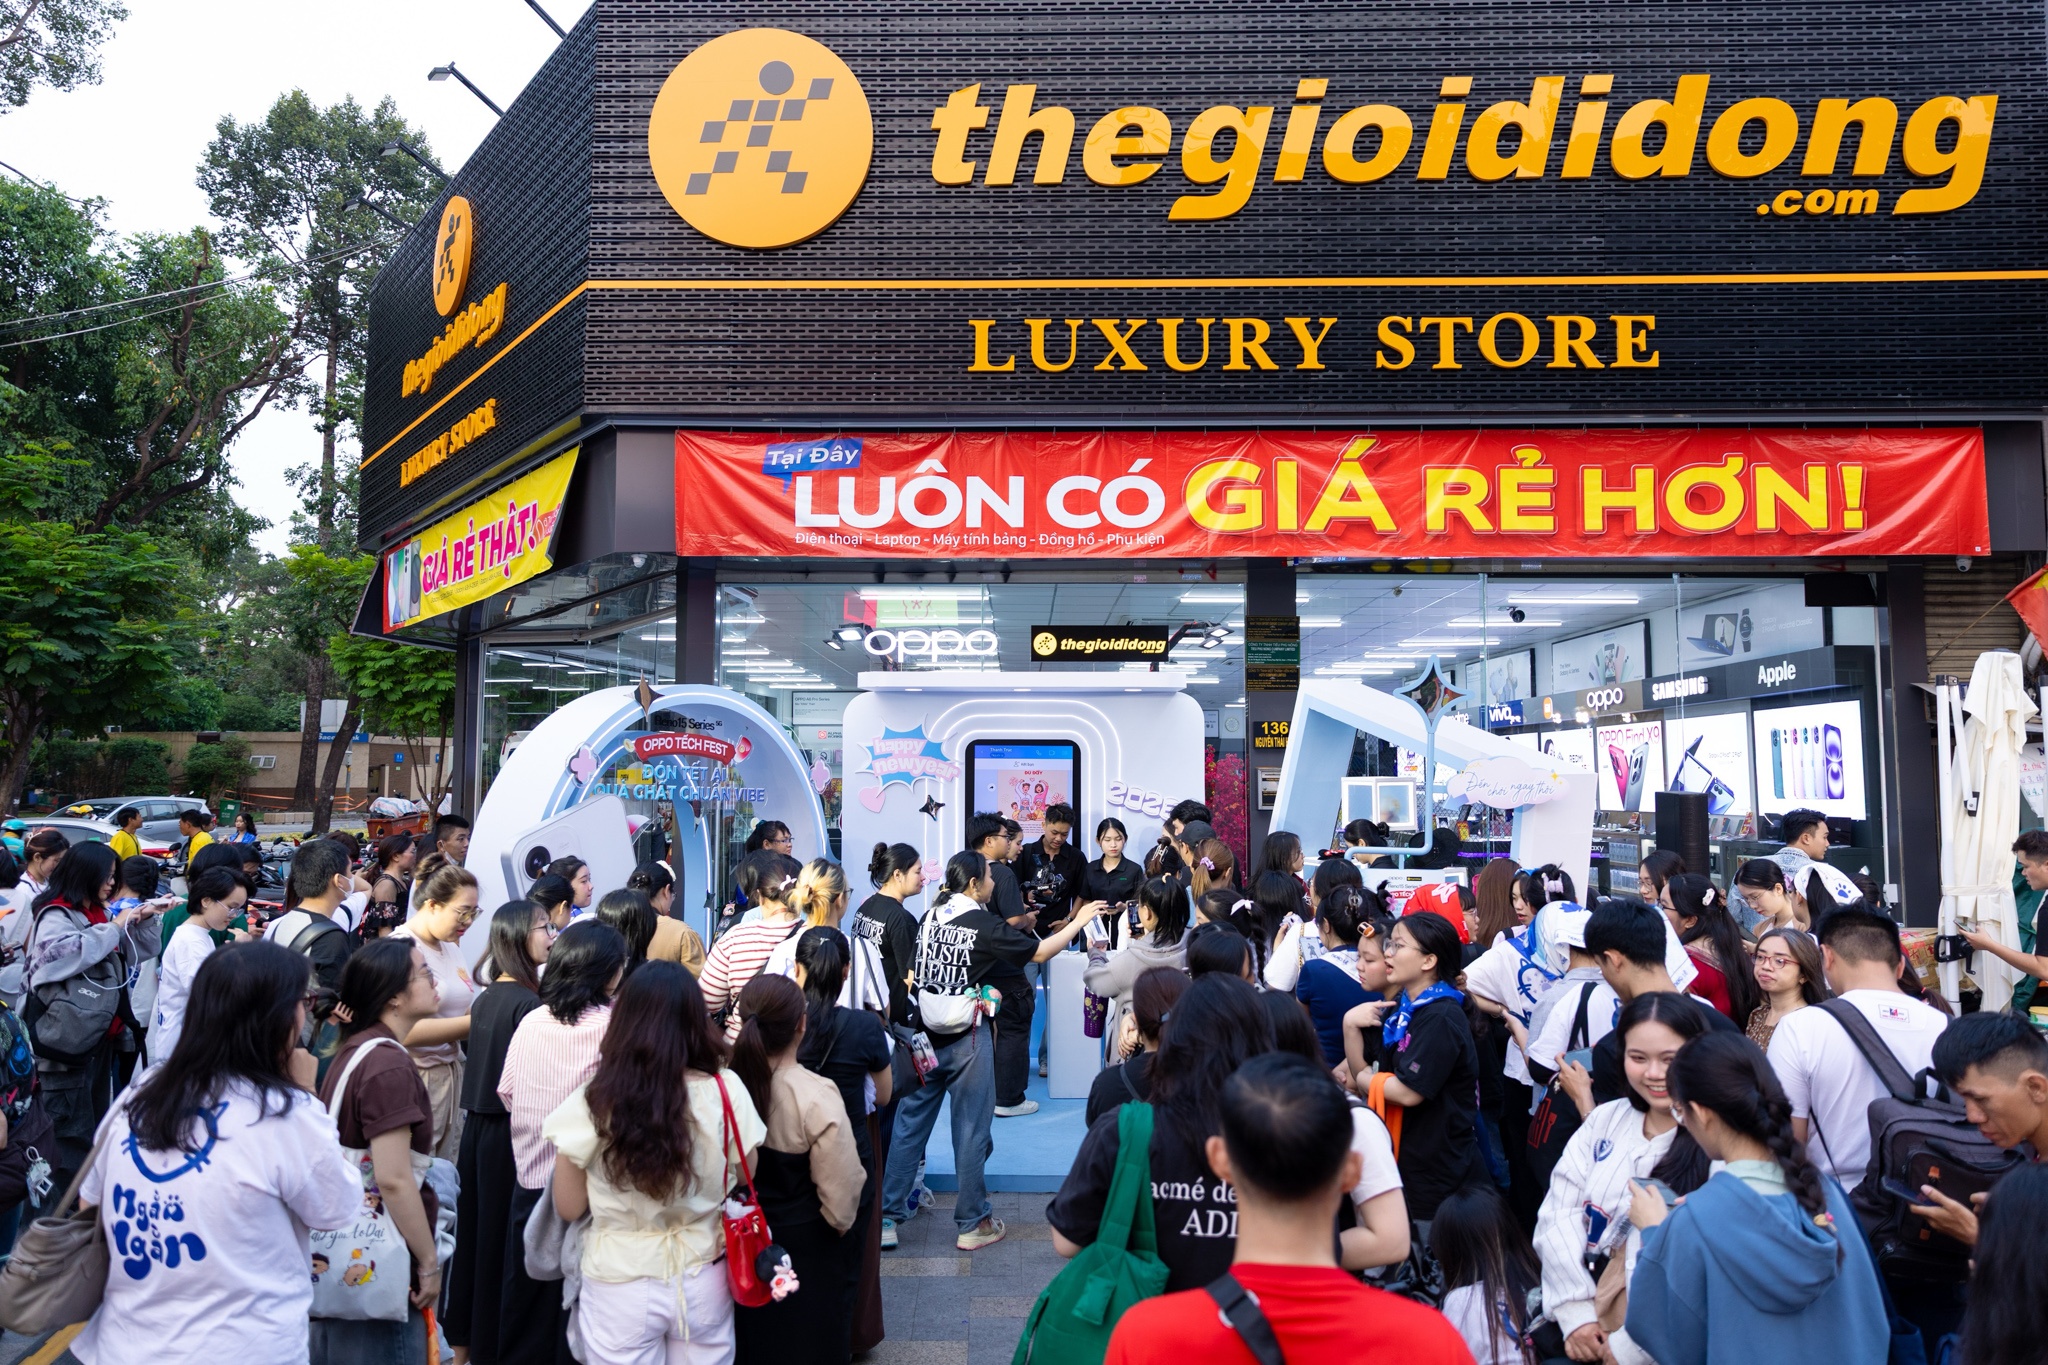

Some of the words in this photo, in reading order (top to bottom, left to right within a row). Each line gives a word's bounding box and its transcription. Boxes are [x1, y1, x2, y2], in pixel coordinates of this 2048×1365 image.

[931, 74, 1999, 219] thegioididong
[1757, 188, 1879, 215] .com
[401, 282, 507, 398] thegioididong
[968, 316, 1337, 372] LUXURY
[1377, 313, 1659, 371] STORE
[400, 432, 450, 488] LUXURY
[450, 398, 496, 453] STORE
[767, 448, 803, 469] Tại
[809, 445, 859, 465] Đây
[795, 458, 1025, 529] LUÔN
[1046, 458, 1166, 529] CÓ
[1184, 438, 1398, 533] GIÁ
[1425, 446, 1556, 533] RẺ
[1582, 454, 1865, 533] HƠN!
[422, 535, 449, 595] GIÁ
[451, 517, 476, 584] RẺ
[478, 500, 539, 580] THẬT!
[795, 532, 826, 547] Điện
[829, 533, 863, 548] thoại
[874, 533, 921, 547] Laptop
[932, 532, 960, 548] Máy
[963, 533, 990, 545] tính
[993, 533, 1027, 547] bảng
[1039, 531, 1075, 547] Đồng
[1078, 531, 1095, 545] hồ
[1107, 533, 1133, 547] Phụ
[1136, 533, 1165, 547] kiện
[864, 629, 998, 663] oppo
[1060, 638, 1166, 653] thegioididong
[1758, 660, 1797, 687] Apple
[1586, 687, 1624, 712] oppo
[1652, 676, 1709, 701] SAMSUNG
[654, 715, 687, 729] Reno15
[688, 719, 715, 731] Series
[1261, 721, 1289, 735] 136
[643, 736, 673, 752] OPPO
[703, 740, 729, 757] FEST
[874, 739, 925, 755] happy
[1598, 729, 1624, 748] OPPO
[1626, 727, 1645, 744] Find
[1646, 725, 1660, 744] X9
[642, 760, 677, 780] ĐÓN
[681, 761, 709, 780] TẾT
[711, 767, 727, 782] AI
[873, 757, 959, 777] newyear
[633, 776, 677, 801] CHẤT
[679, 781, 731, 802] CHUẨN
[734, 787, 765, 803] VIBE
[1465, 771, 1490, 792] Đến
[1487, 782, 1508, 796] chơi
[1510, 783, 1536, 802] ngay
[78, 987, 101, 999] acer
